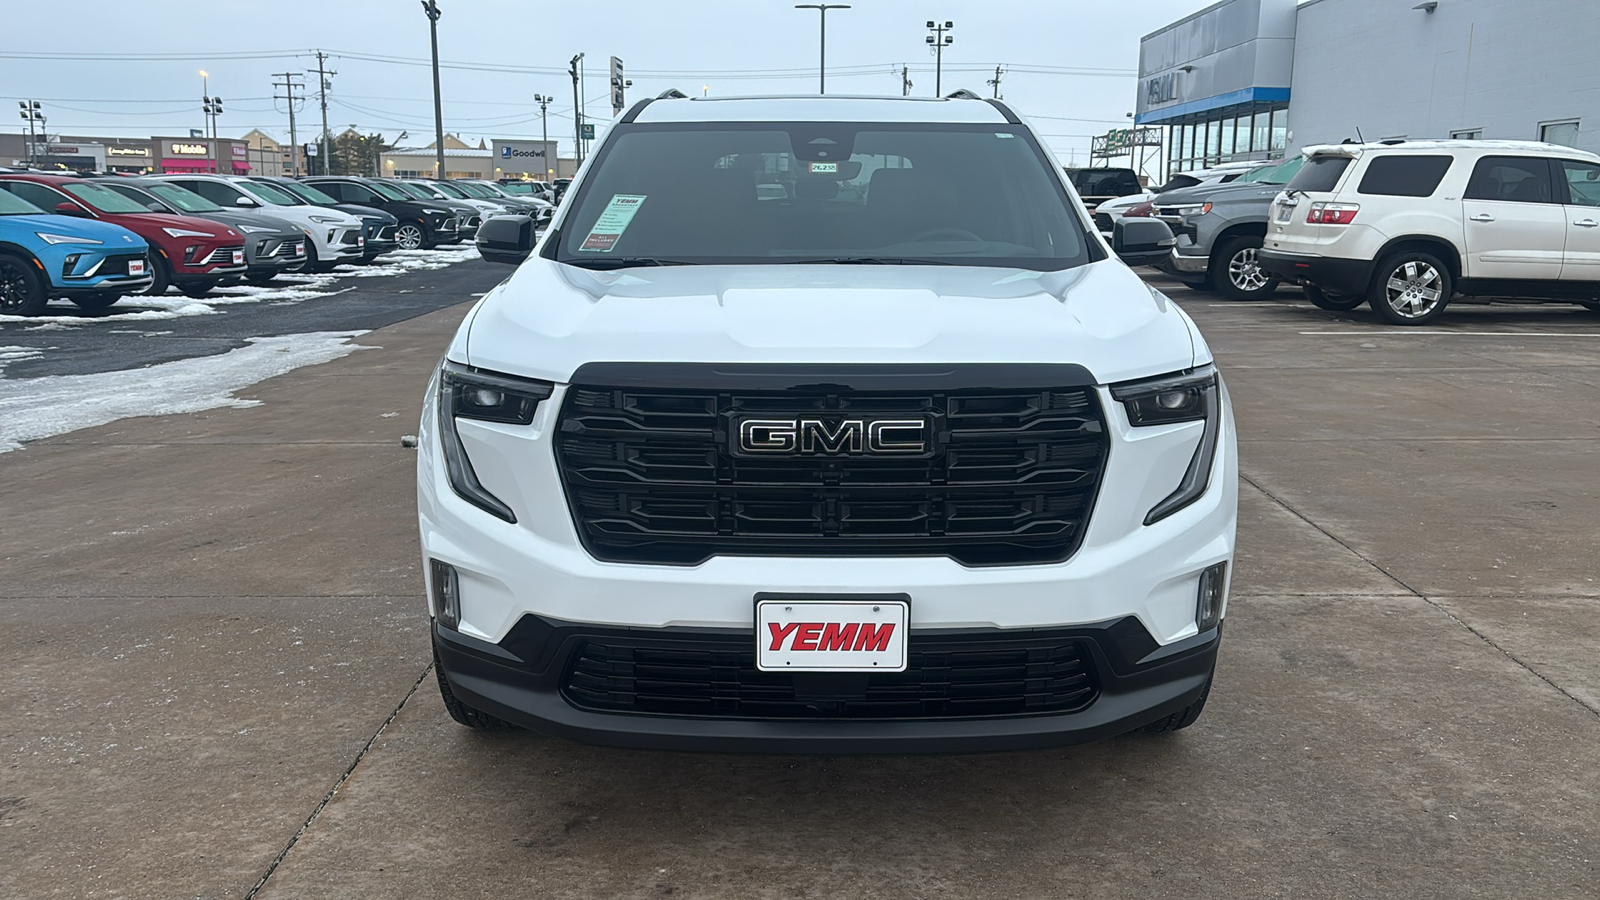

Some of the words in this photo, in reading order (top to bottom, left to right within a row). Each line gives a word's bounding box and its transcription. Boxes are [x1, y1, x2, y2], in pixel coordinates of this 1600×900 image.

[512, 149, 546, 157] Goodwil
[740, 419, 925, 452] GMC
[768, 623, 896, 651] YEMM
